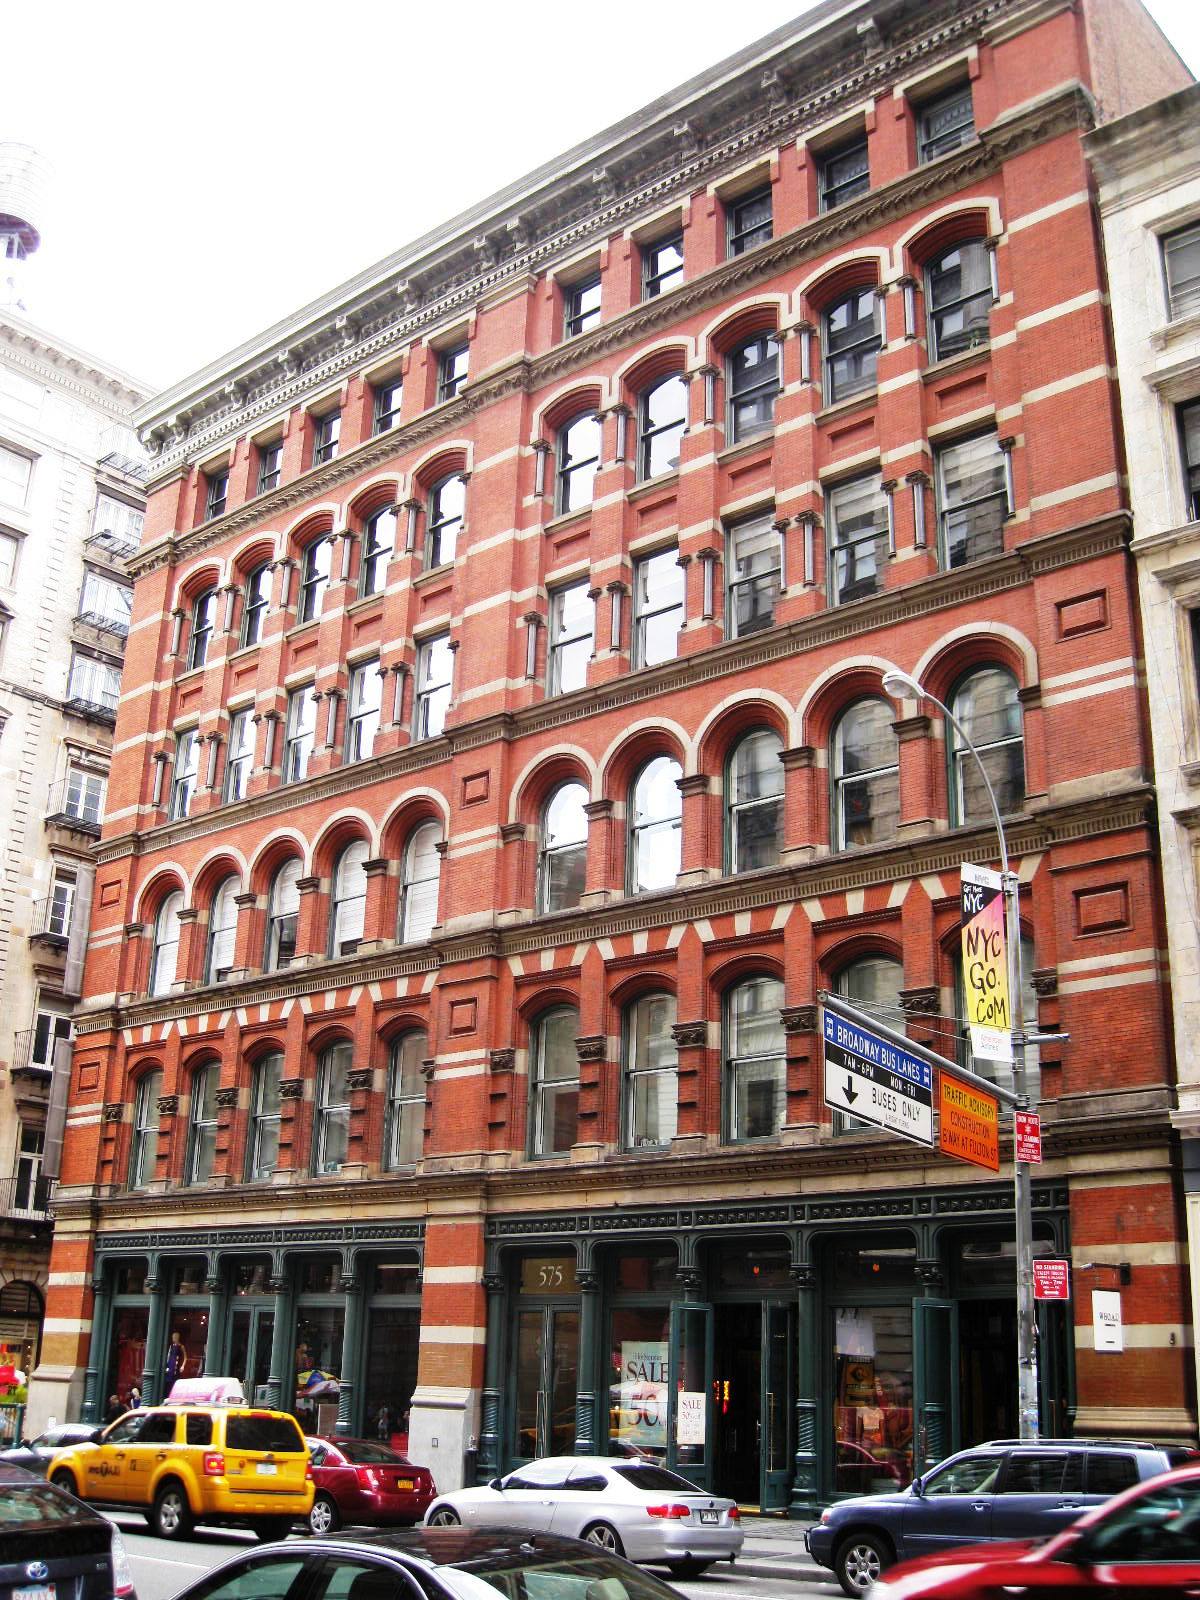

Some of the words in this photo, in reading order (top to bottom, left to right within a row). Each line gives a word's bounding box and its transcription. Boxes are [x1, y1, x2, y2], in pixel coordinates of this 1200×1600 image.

[963, 893, 984, 914] NYC
[966, 925, 1001, 962] NYC
[837, 1024, 880, 1061] BROADWAY
[881, 1047, 896, 1070] BUS
[897, 1055, 921, 1081] LANES
[871, 1087, 897, 1113] BUSES
[902, 1101, 921, 1121] ONLY
[943, 1084, 968, 1108] TRAFFIC
[968, 1098, 995, 1120] ADVISORY
[950, 1110, 990, 1139] CONSTRUCTION
[539, 1265, 563, 1287] 575
[626, 1361, 669, 1383] SALE
[681, 1399, 702, 1410] SALE
